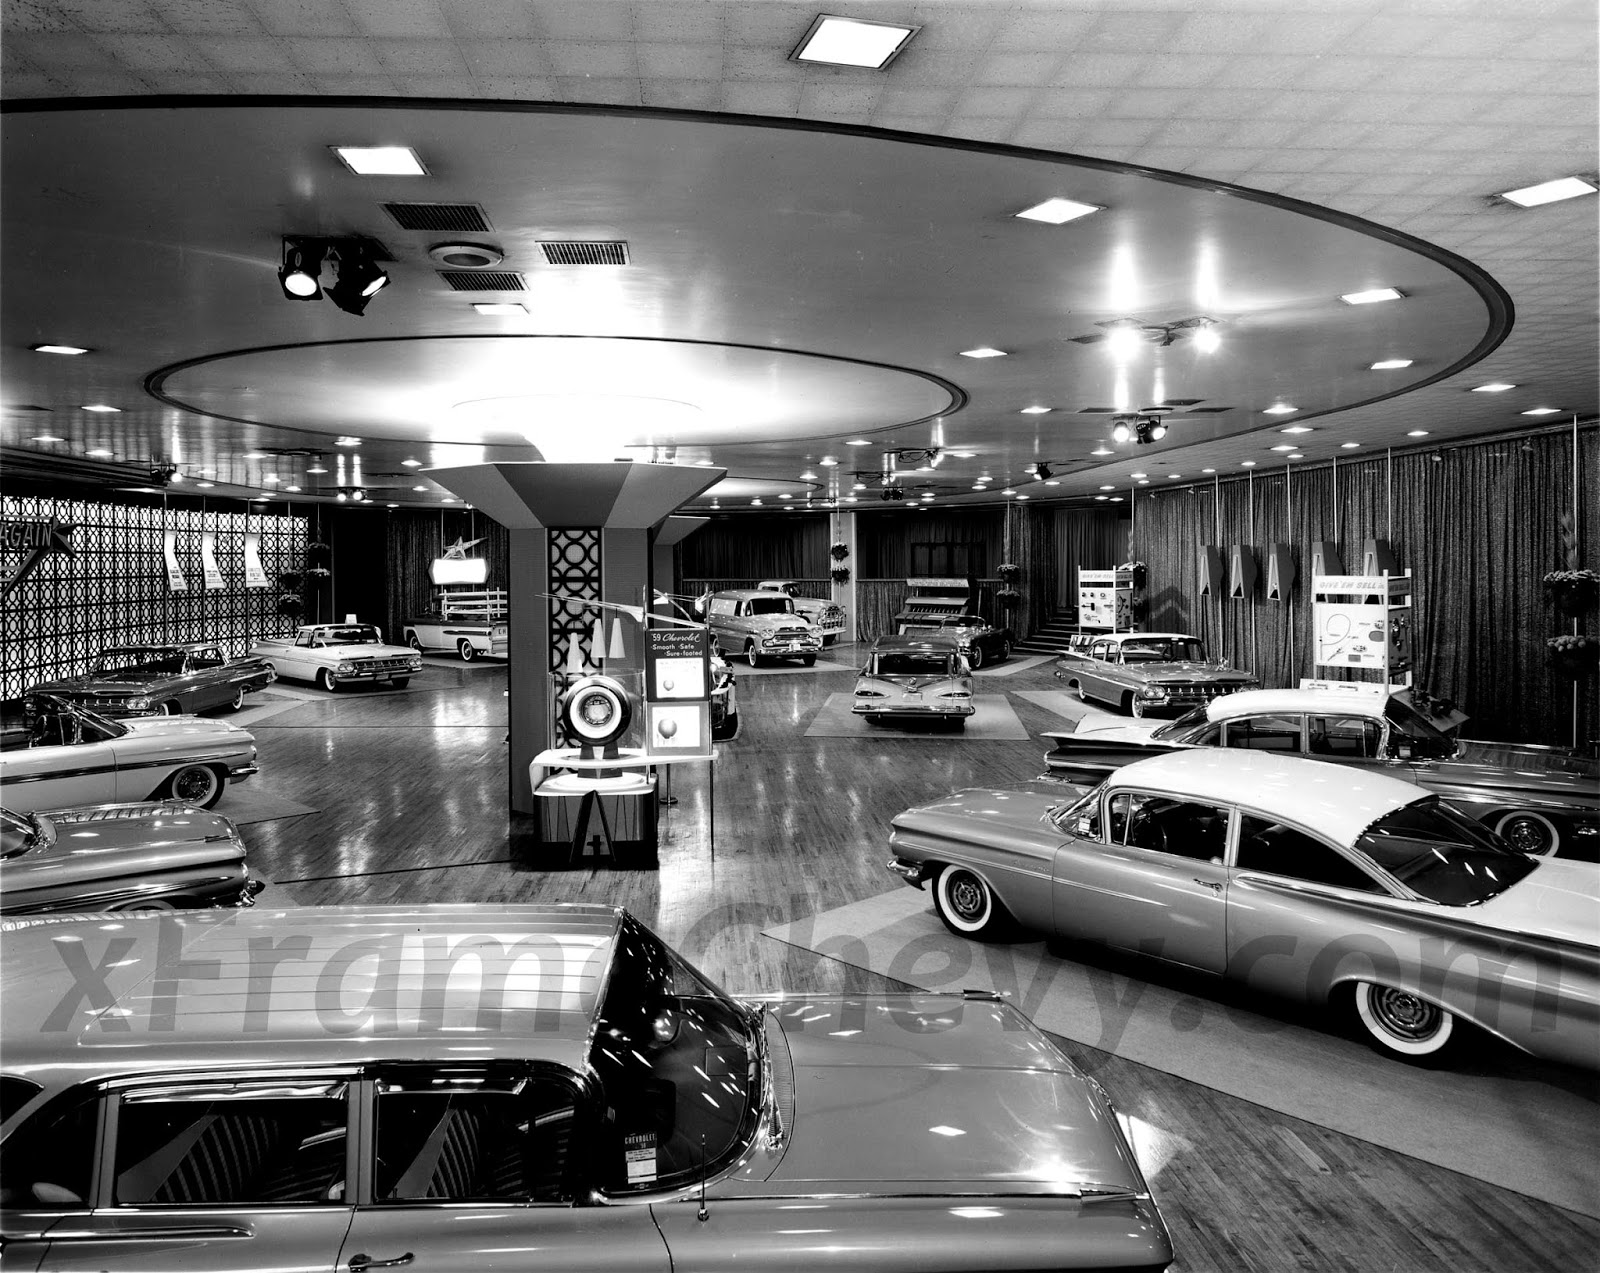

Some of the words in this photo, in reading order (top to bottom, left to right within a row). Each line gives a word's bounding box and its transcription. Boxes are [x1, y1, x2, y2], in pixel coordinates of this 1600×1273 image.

[0, 522, 52, 546] AGAIN
[662, 632, 701, 643] Chevrolet
[652, 643, 676, 651] Smooth
[625, 1133, 656, 1145] CHEVROLET
